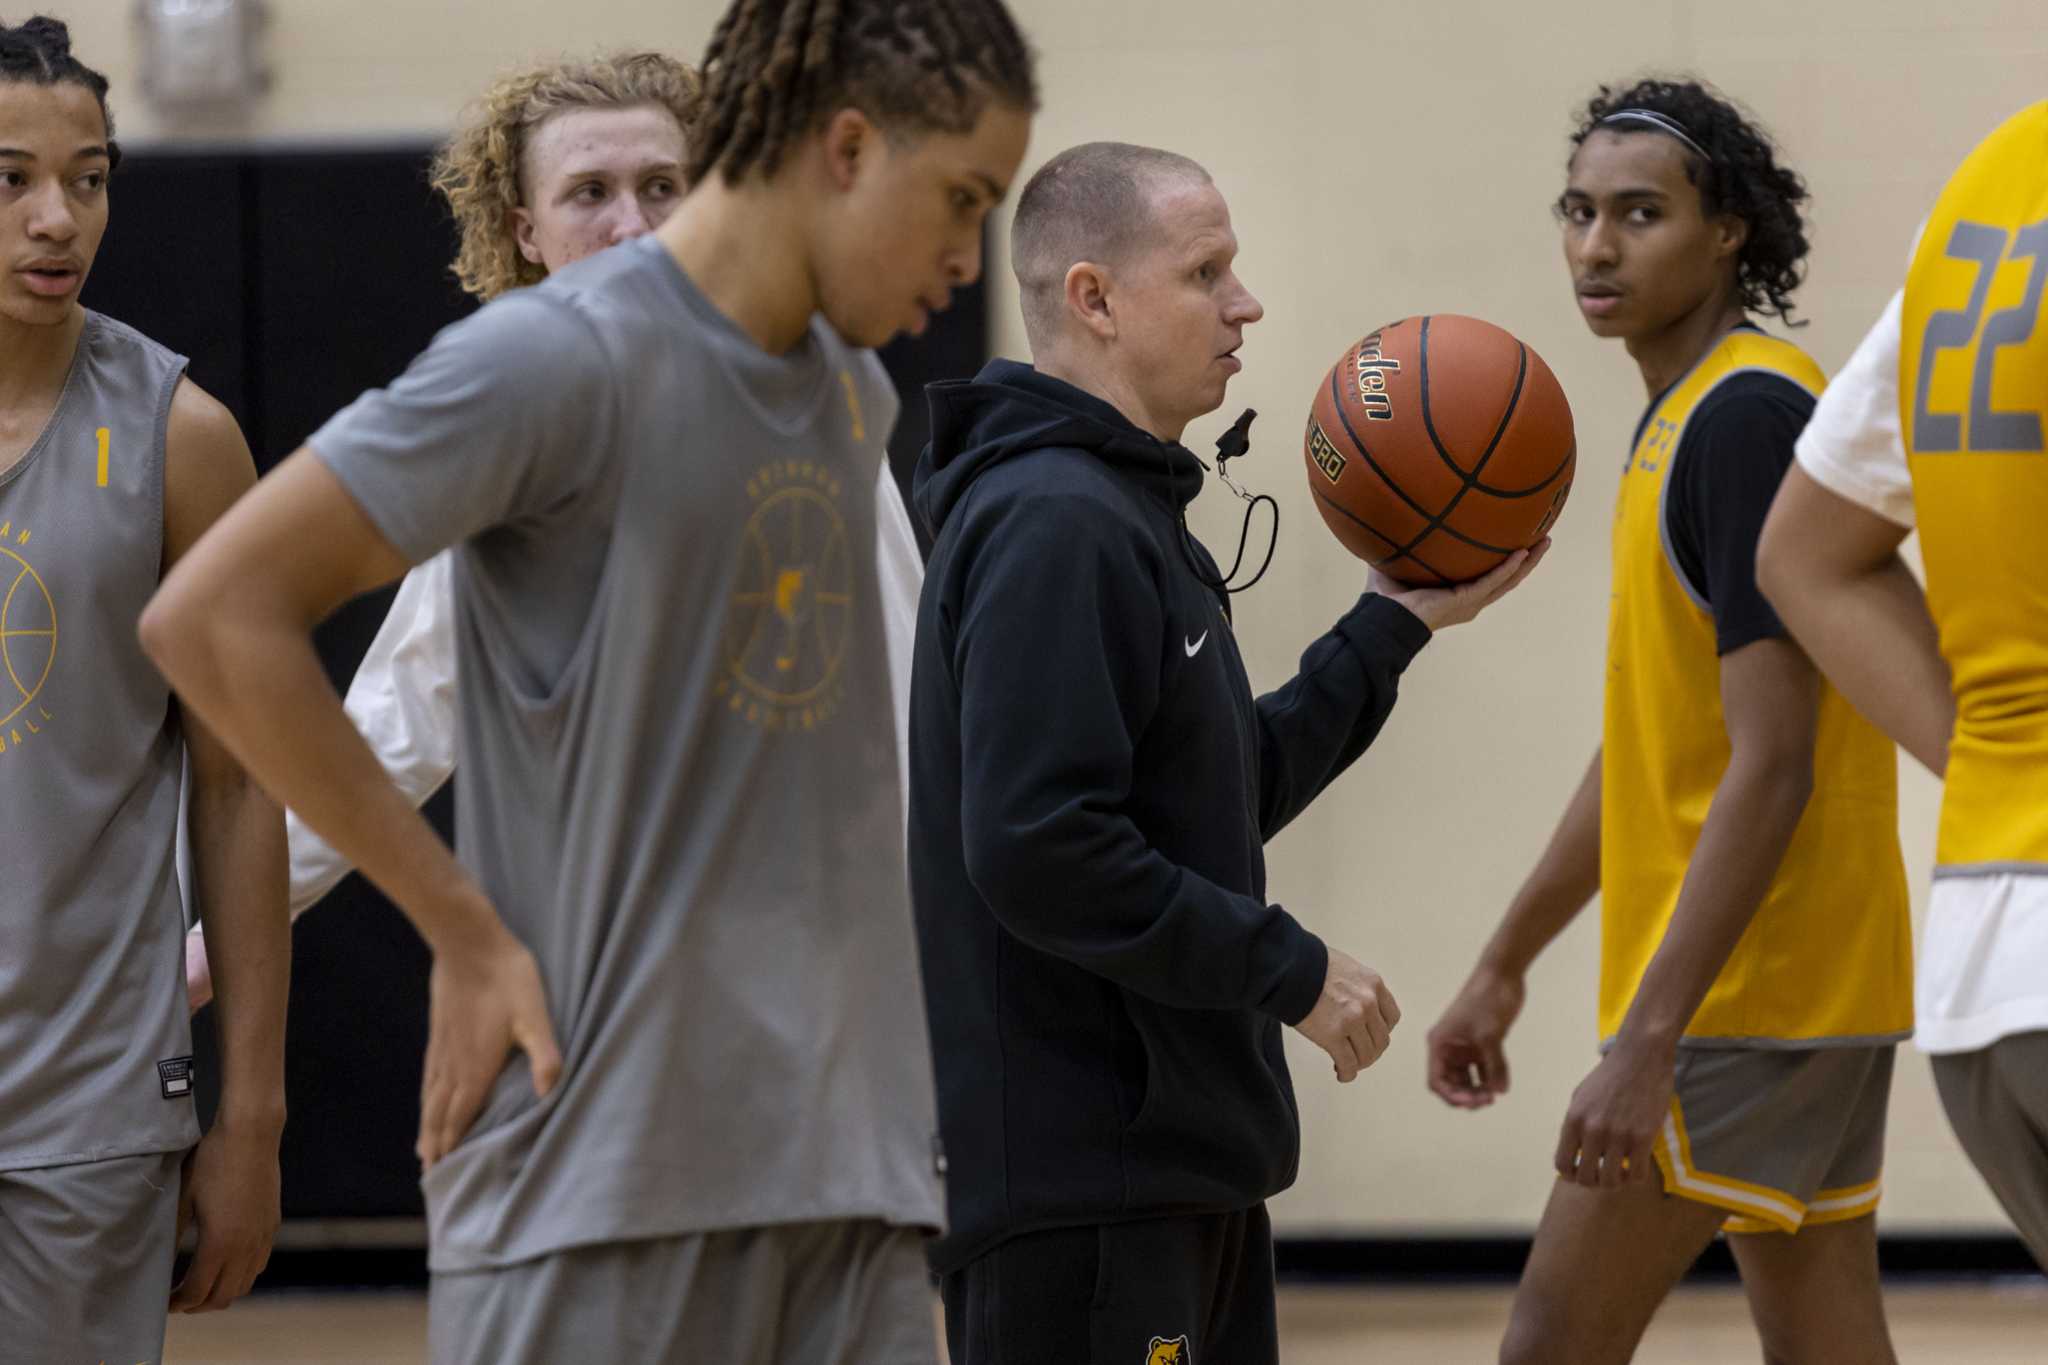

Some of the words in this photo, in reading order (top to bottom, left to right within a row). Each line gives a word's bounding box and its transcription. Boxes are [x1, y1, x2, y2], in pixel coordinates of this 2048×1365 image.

[1357, 320, 1402, 420] aden
[1912, 218, 2048, 452] 22
[95, 427, 111, 488] 1
[1311, 431, 1343, 478] PRO
